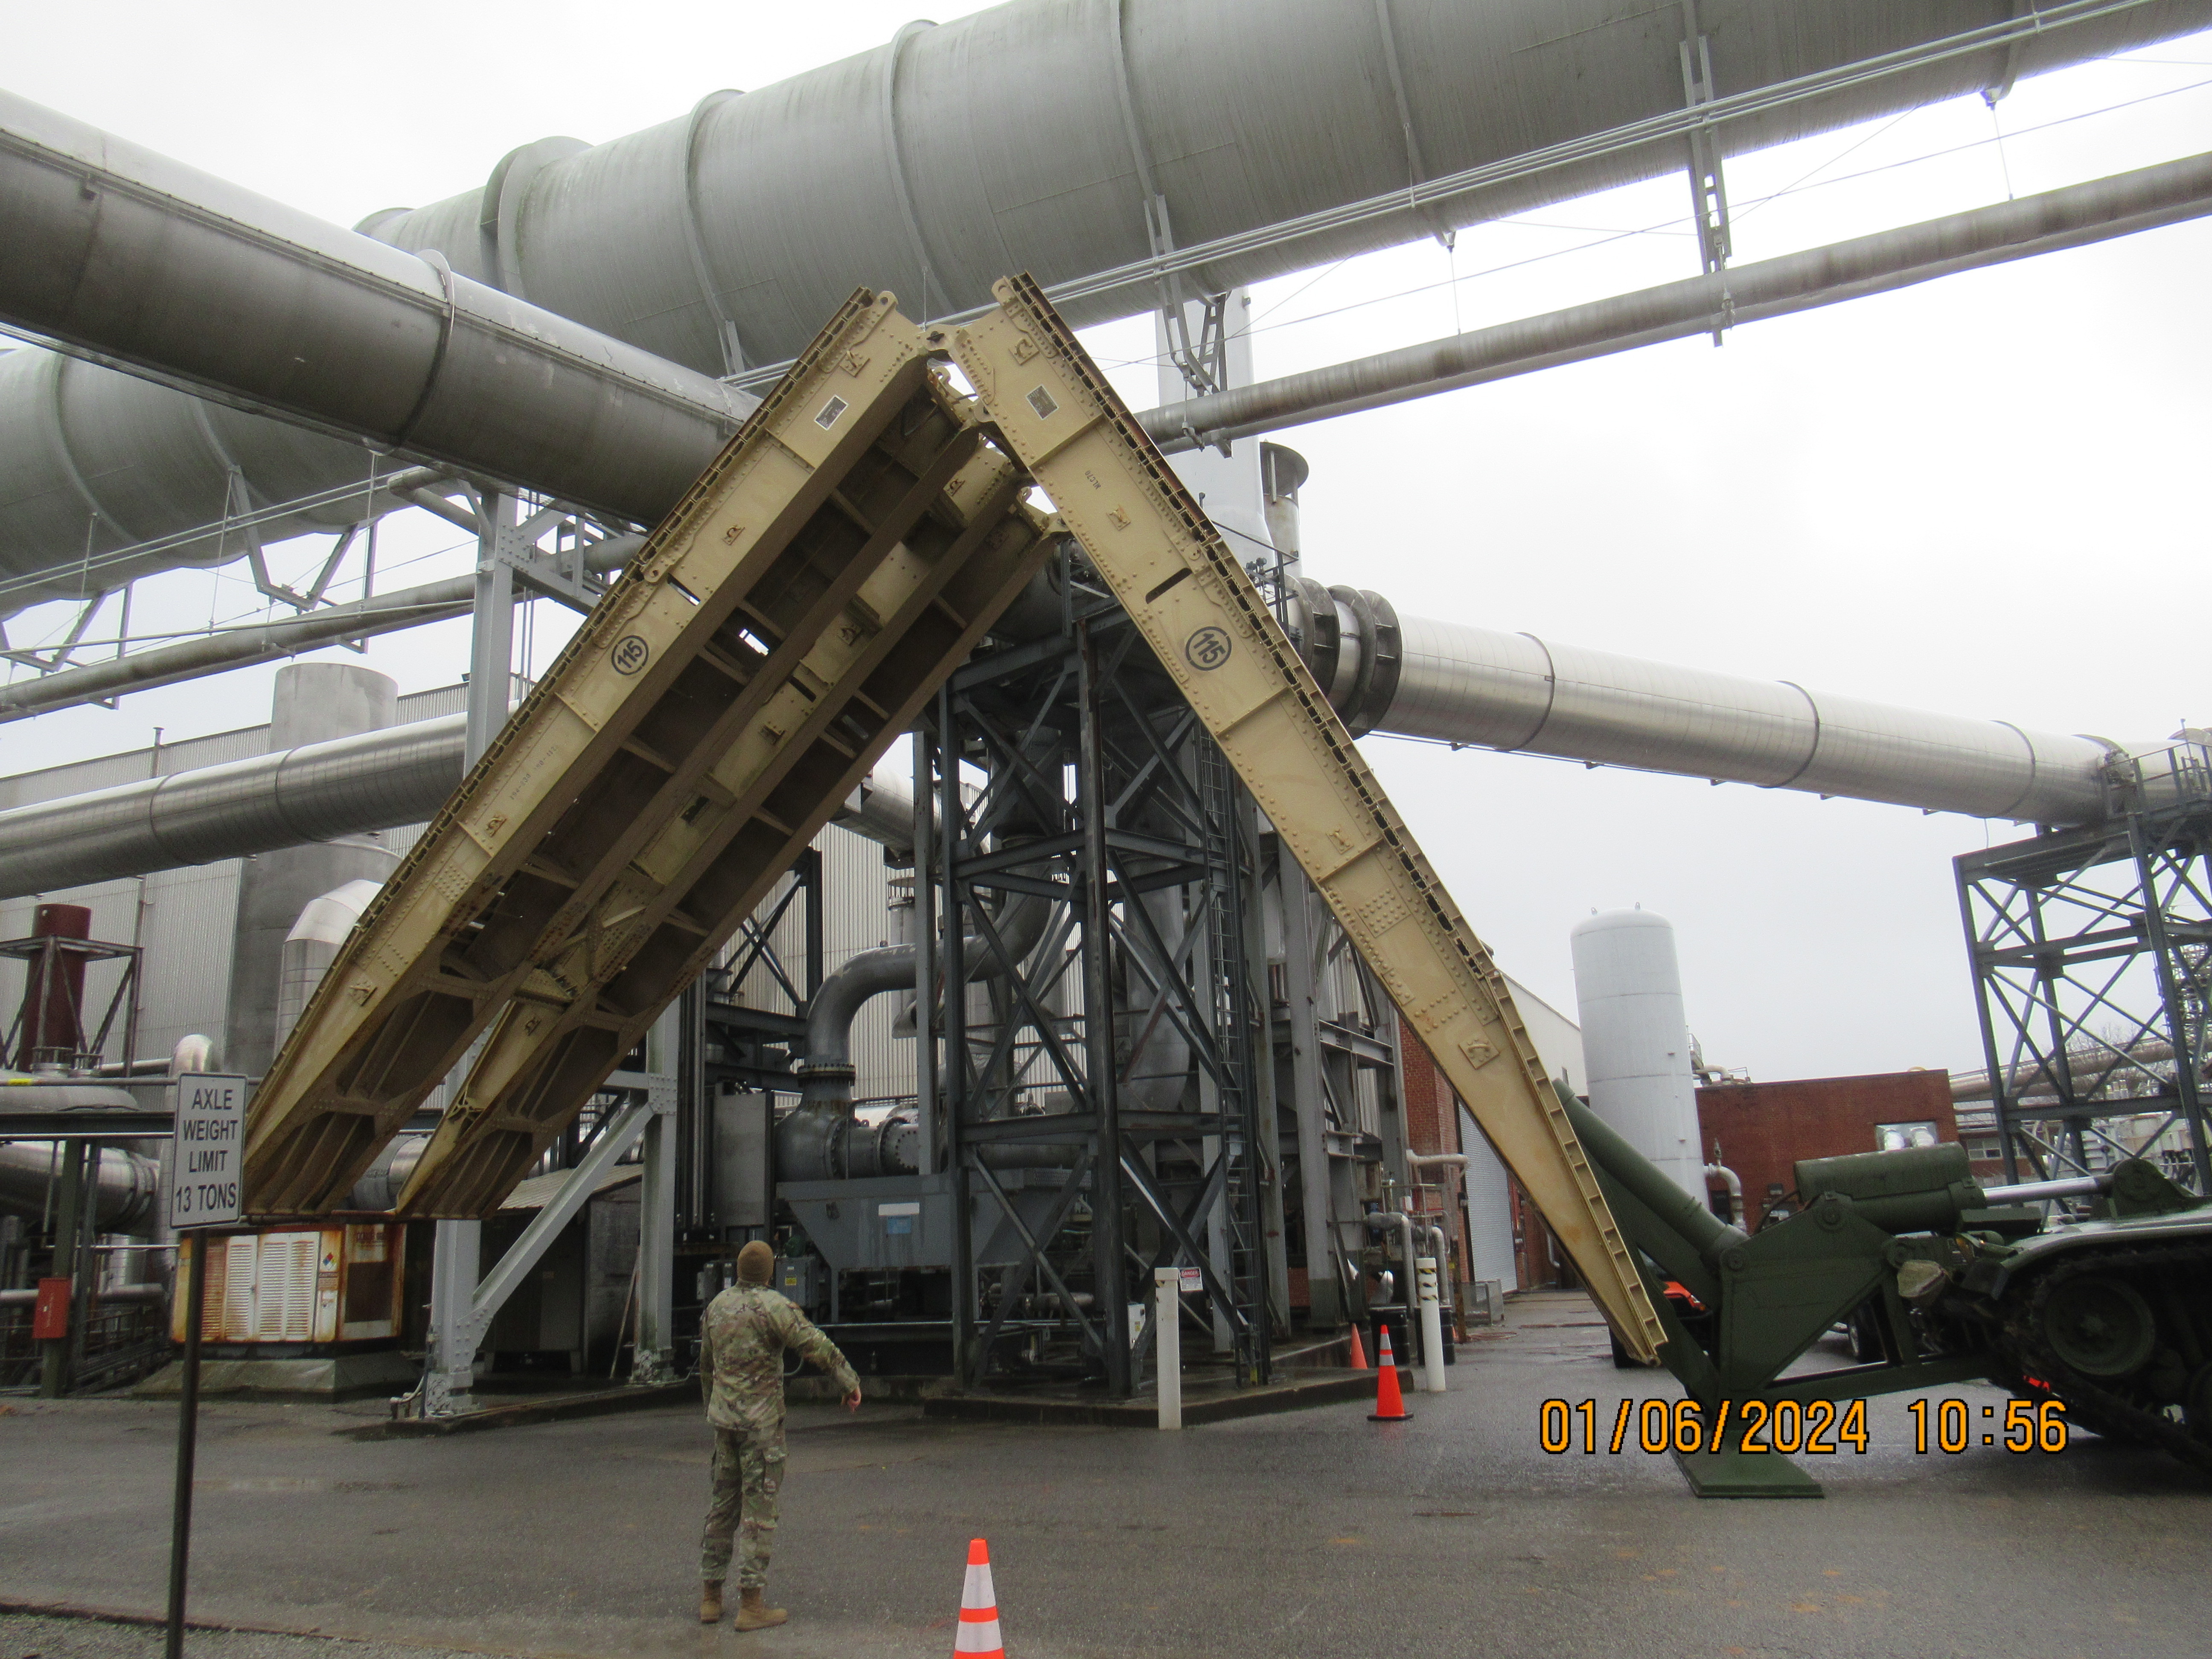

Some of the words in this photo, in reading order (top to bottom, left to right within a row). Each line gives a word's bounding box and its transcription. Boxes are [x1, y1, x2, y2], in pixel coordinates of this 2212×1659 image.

[1085, 470, 1101, 489] MLC70
[617, 640, 643, 669] 115
[1193, 633, 1226, 664] 115
[192, 1089, 233, 1110] AXLE
[183, 1120, 238, 1141] WEIGHT
[189, 1150, 227, 1173] LIMIT
[176, 1185, 191, 1212] 13
[198, 1183, 237, 1211] TONS
